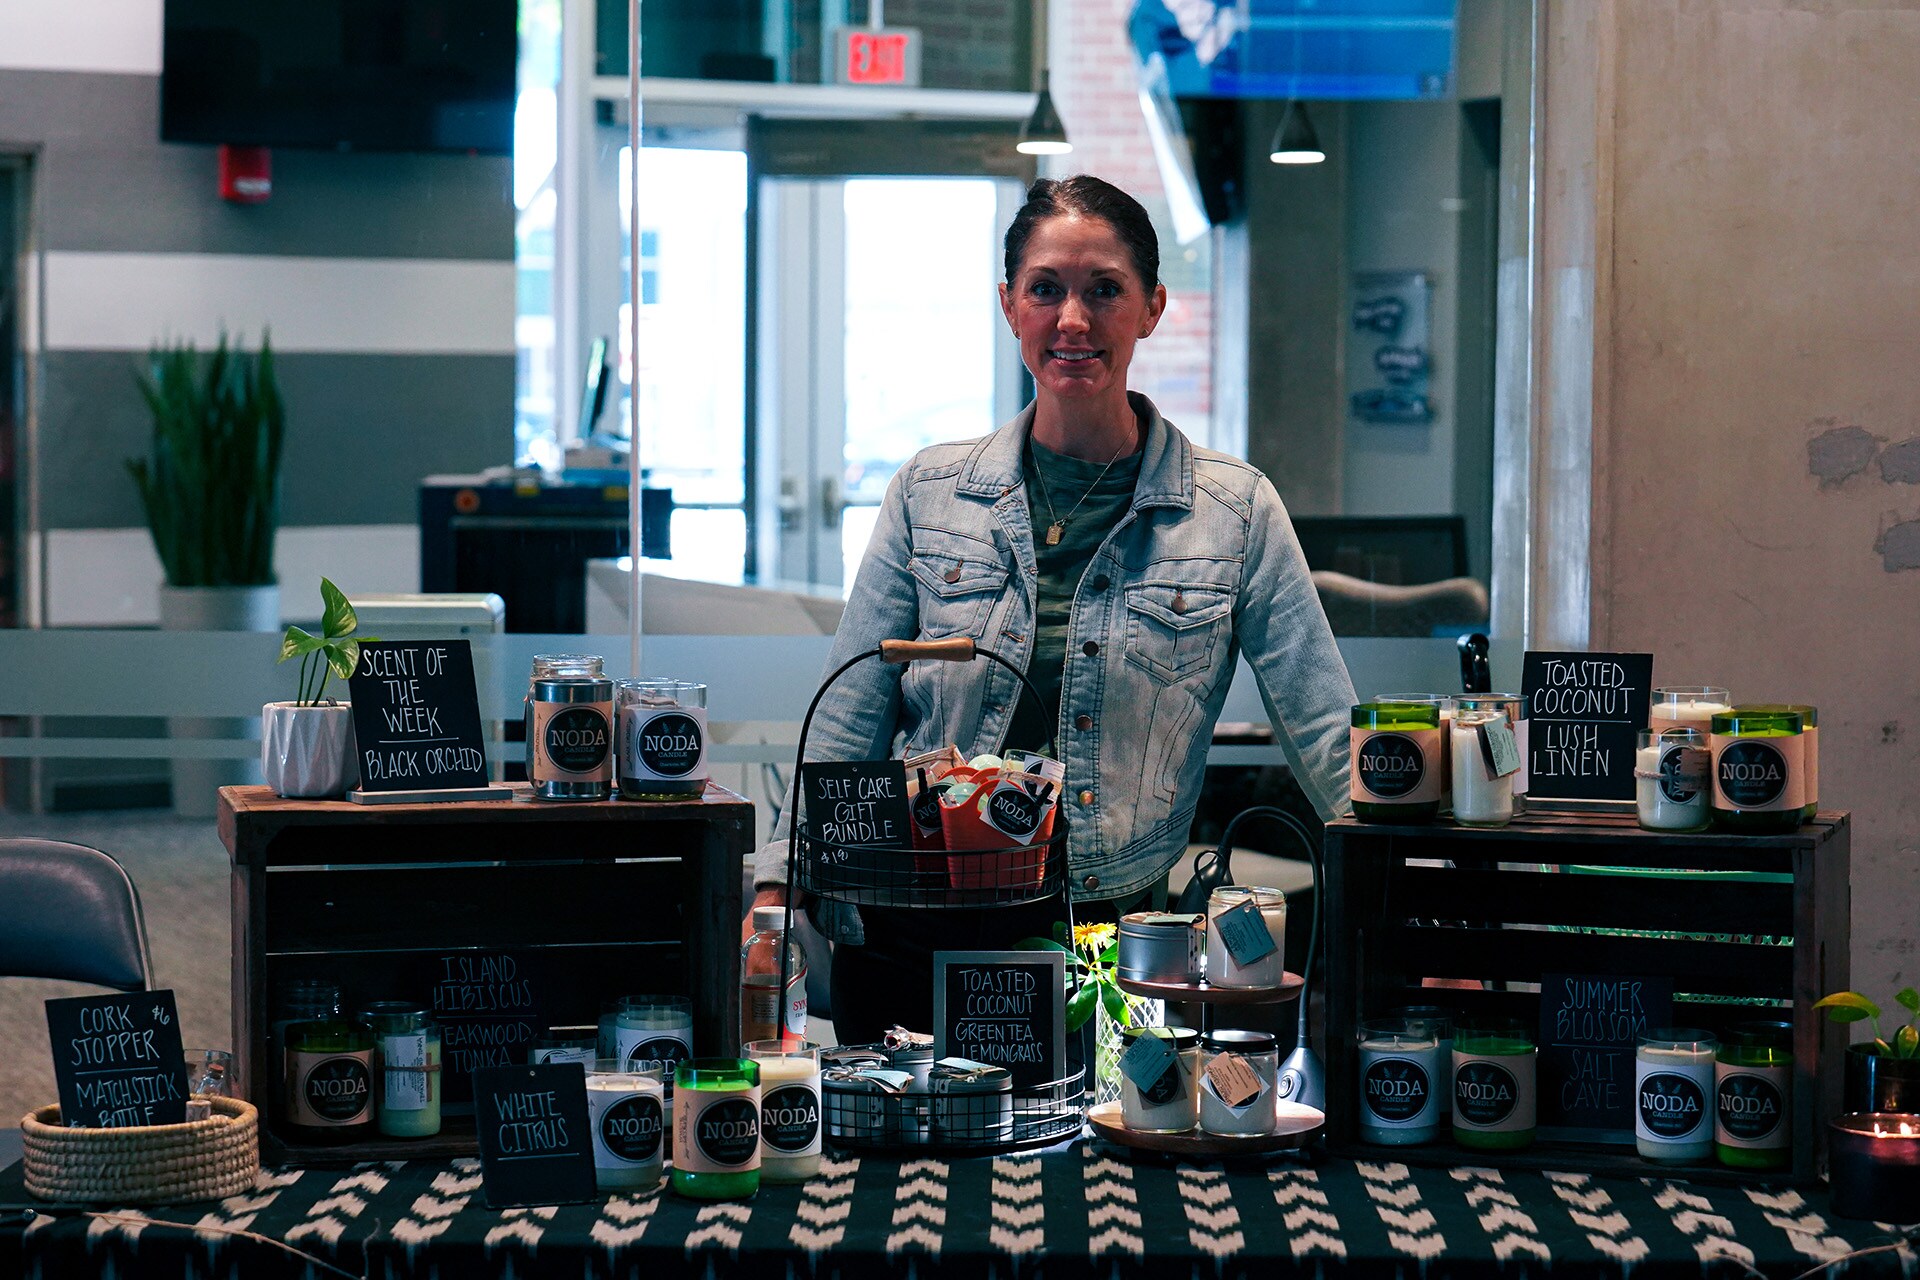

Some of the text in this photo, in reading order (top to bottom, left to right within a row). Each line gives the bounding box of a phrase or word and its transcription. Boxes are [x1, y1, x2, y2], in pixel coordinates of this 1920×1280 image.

[848, 31, 909, 84] EXIT
[362, 647, 448, 676] SCENT OF
[1542, 660, 1625, 688] TOASTED
[383, 679, 424, 705] THE
[1534, 687, 1635, 714] COCONUT
[382, 707, 443, 736] WEEK
[551, 729, 606, 746] NODA
[644, 734, 699, 752] NODA
[1547, 724, 1598, 750] LUSH
[365, 747, 482, 780] BLACK ORCHID
[1362, 754, 1419, 772] NODA
[1533, 749, 1609, 776] LINEN
[1721, 763, 1781, 781] NODA
[819, 777, 896, 799] SELF CARE
[835, 801, 876, 823] GIFT
[994, 797, 1034, 828] NODA
[822, 820, 897, 843] BUNDLE
[441, 955, 516, 983] ISLAND
[958, 969, 1036, 993] TOASTED
[434, 979, 532, 1011] HIBISCUS
[966, 993, 1037, 1016] COCONUT
[1562, 977, 1645, 1014] SUMMER
[80, 1004, 134, 1034] CORK
[152, 1005, 170, 1025] $6
[1556, 1009, 1647, 1042] BLOSSOM
[441, 1021, 532, 1046] EAKWOOD
[955, 1022, 1034, 1042] GREEN TEA
[71, 1029, 160, 1066] STOPPER
[448, 1046, 512, 1073] TONKA
[1570, 1048, 1621, 1081] SALT
[76, 1072, 181, 1109] MATCHSTICK
[312, 1077, 367, 1096] NODA
[1368, 1078, 1424, 1096] NODA
[1457, 1081, 1511, 1100] NODA
[1561, 1081, 1620, 1111] CAVE
[494, 1091, 561, 1120] WHITE
[1642, 1091, 1699, 1112] NODA
[1652, 1110, 1684, 1118] CANDLE
[1720, 1093, 1776, 1114] NODA
[609, 1115, 661, 1136] NODA
[763, 1105, 818, 1126] NODA
[777, 1123, 808, 1132] CANDLE
[499, 1117, 569, 1153] CITRUS
[703, 1118, 758, 1139] NODA
